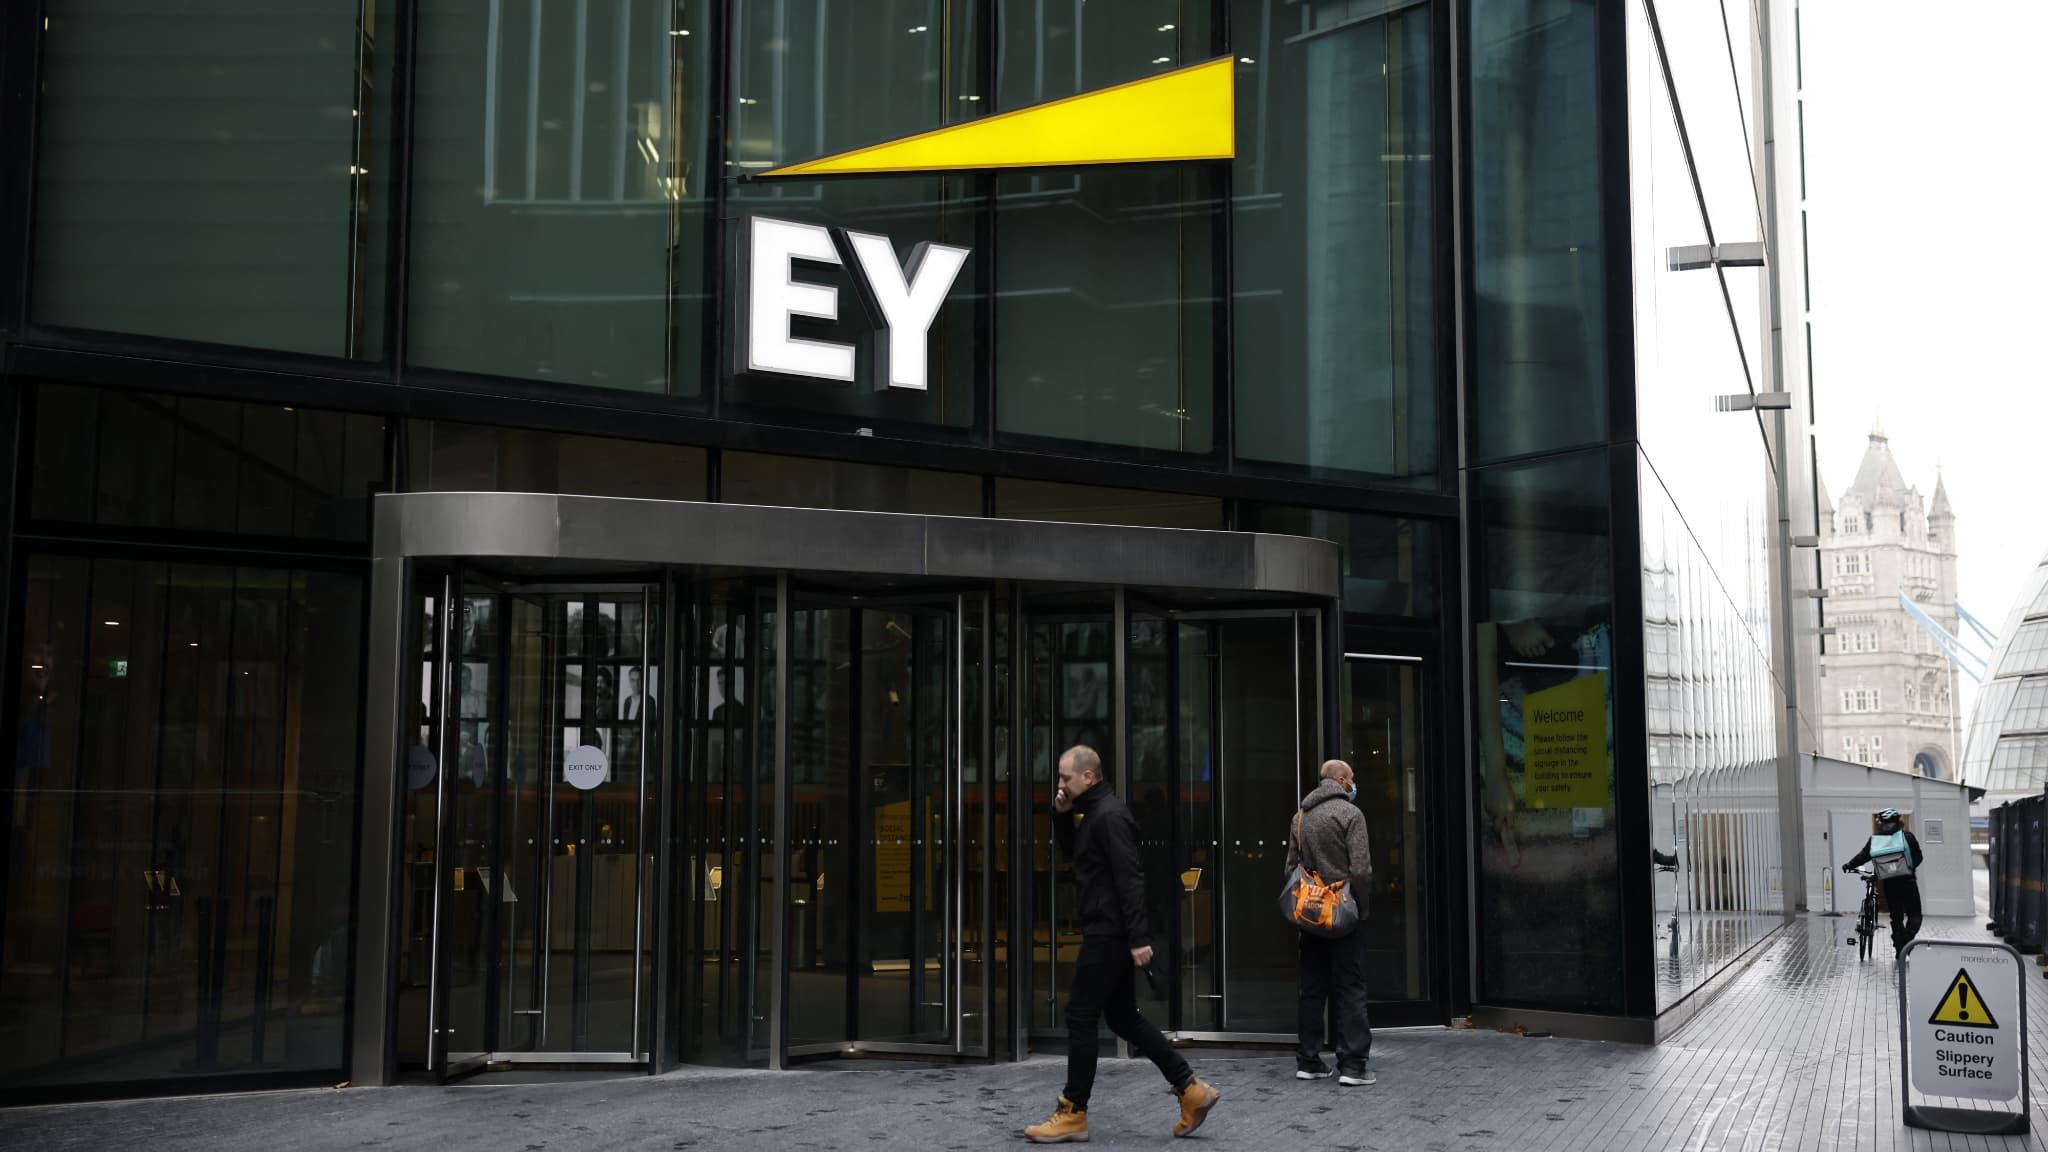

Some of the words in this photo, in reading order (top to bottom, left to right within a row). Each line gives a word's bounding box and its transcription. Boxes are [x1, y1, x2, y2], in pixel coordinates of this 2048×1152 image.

[748, 215, 971, 390] EY
[1533, 710, 1584, 724] Welcome
[1935, 1029, 1994, 1045] Caution
[1936, 1049, 1994, 1067] Slippery
[1938, 1064, 1993, 1080] Surface
